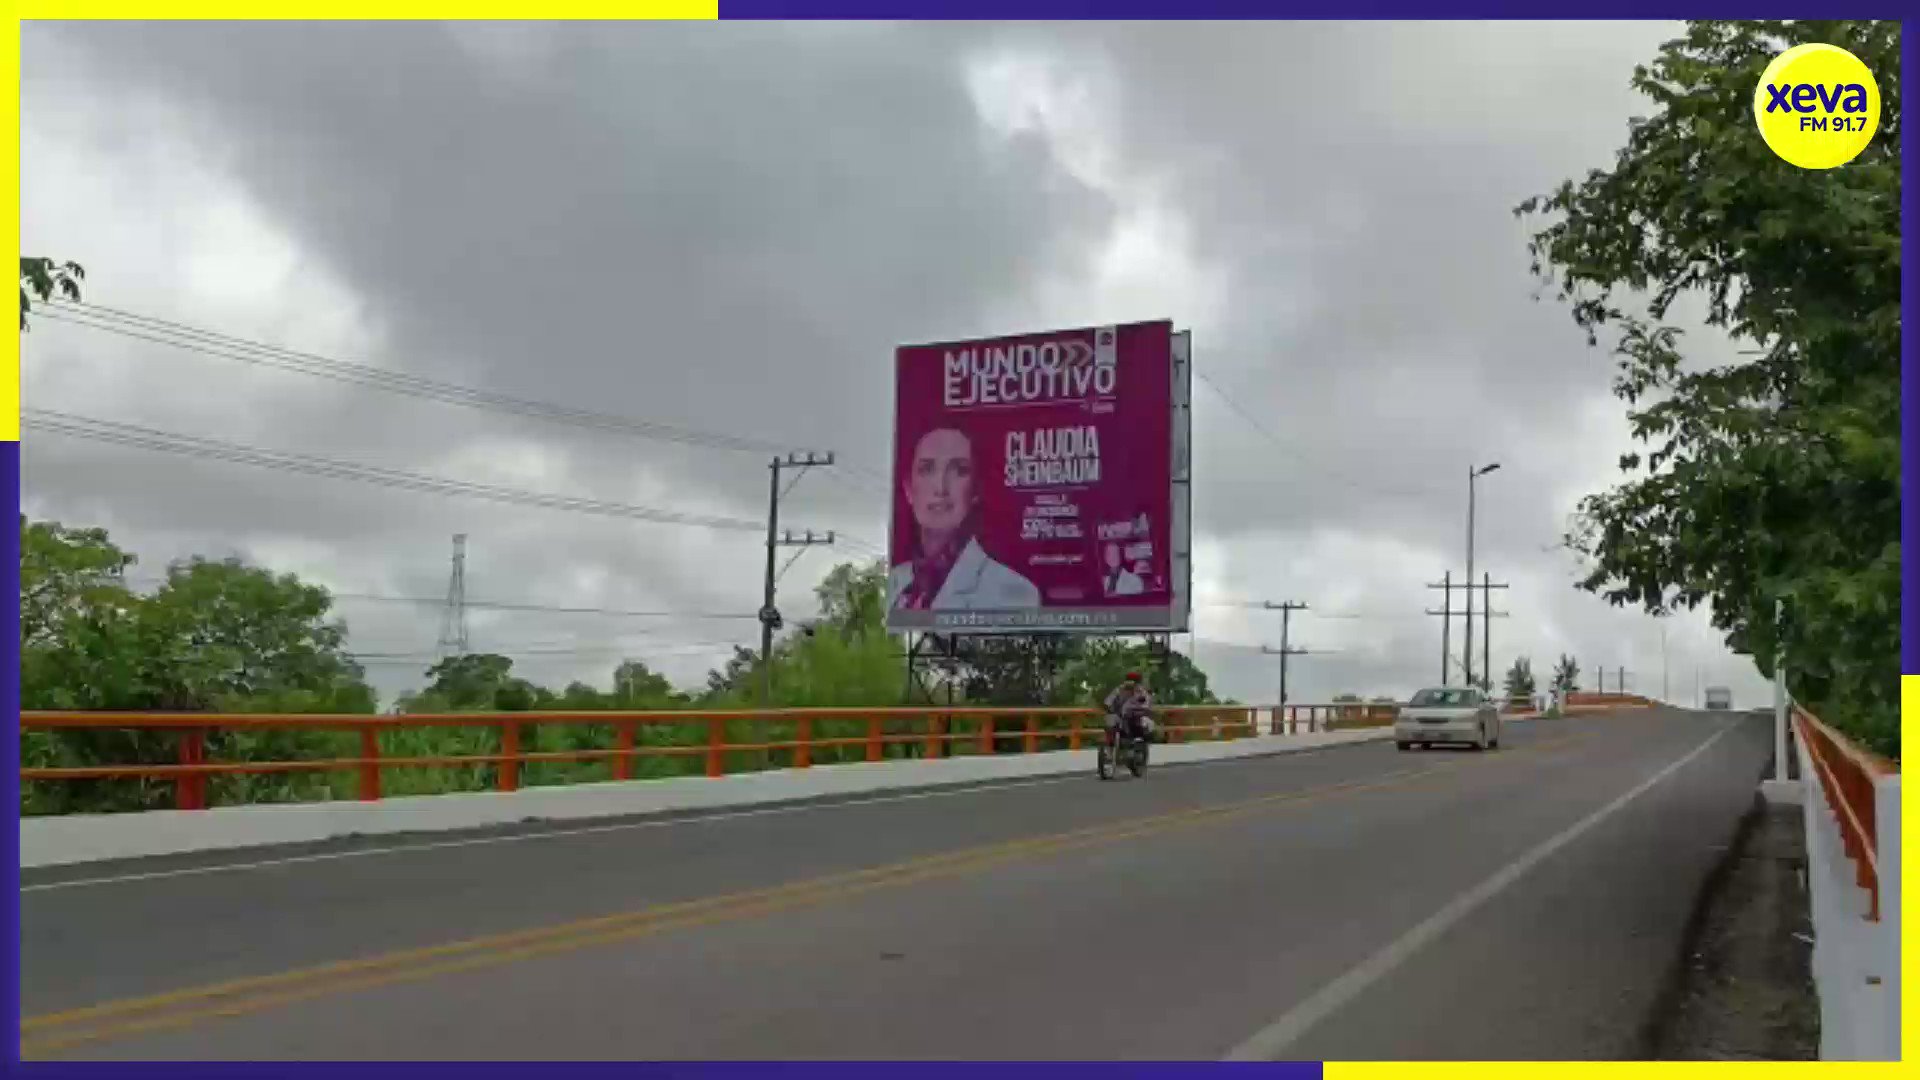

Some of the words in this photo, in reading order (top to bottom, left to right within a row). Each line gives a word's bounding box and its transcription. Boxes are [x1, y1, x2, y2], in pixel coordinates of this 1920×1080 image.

[944, 342, 1060, 377] MUNDO
[944, 366, 1117, 407] EJECUTIVO
[1005, 425, 1099, 461] CLAUDIA
